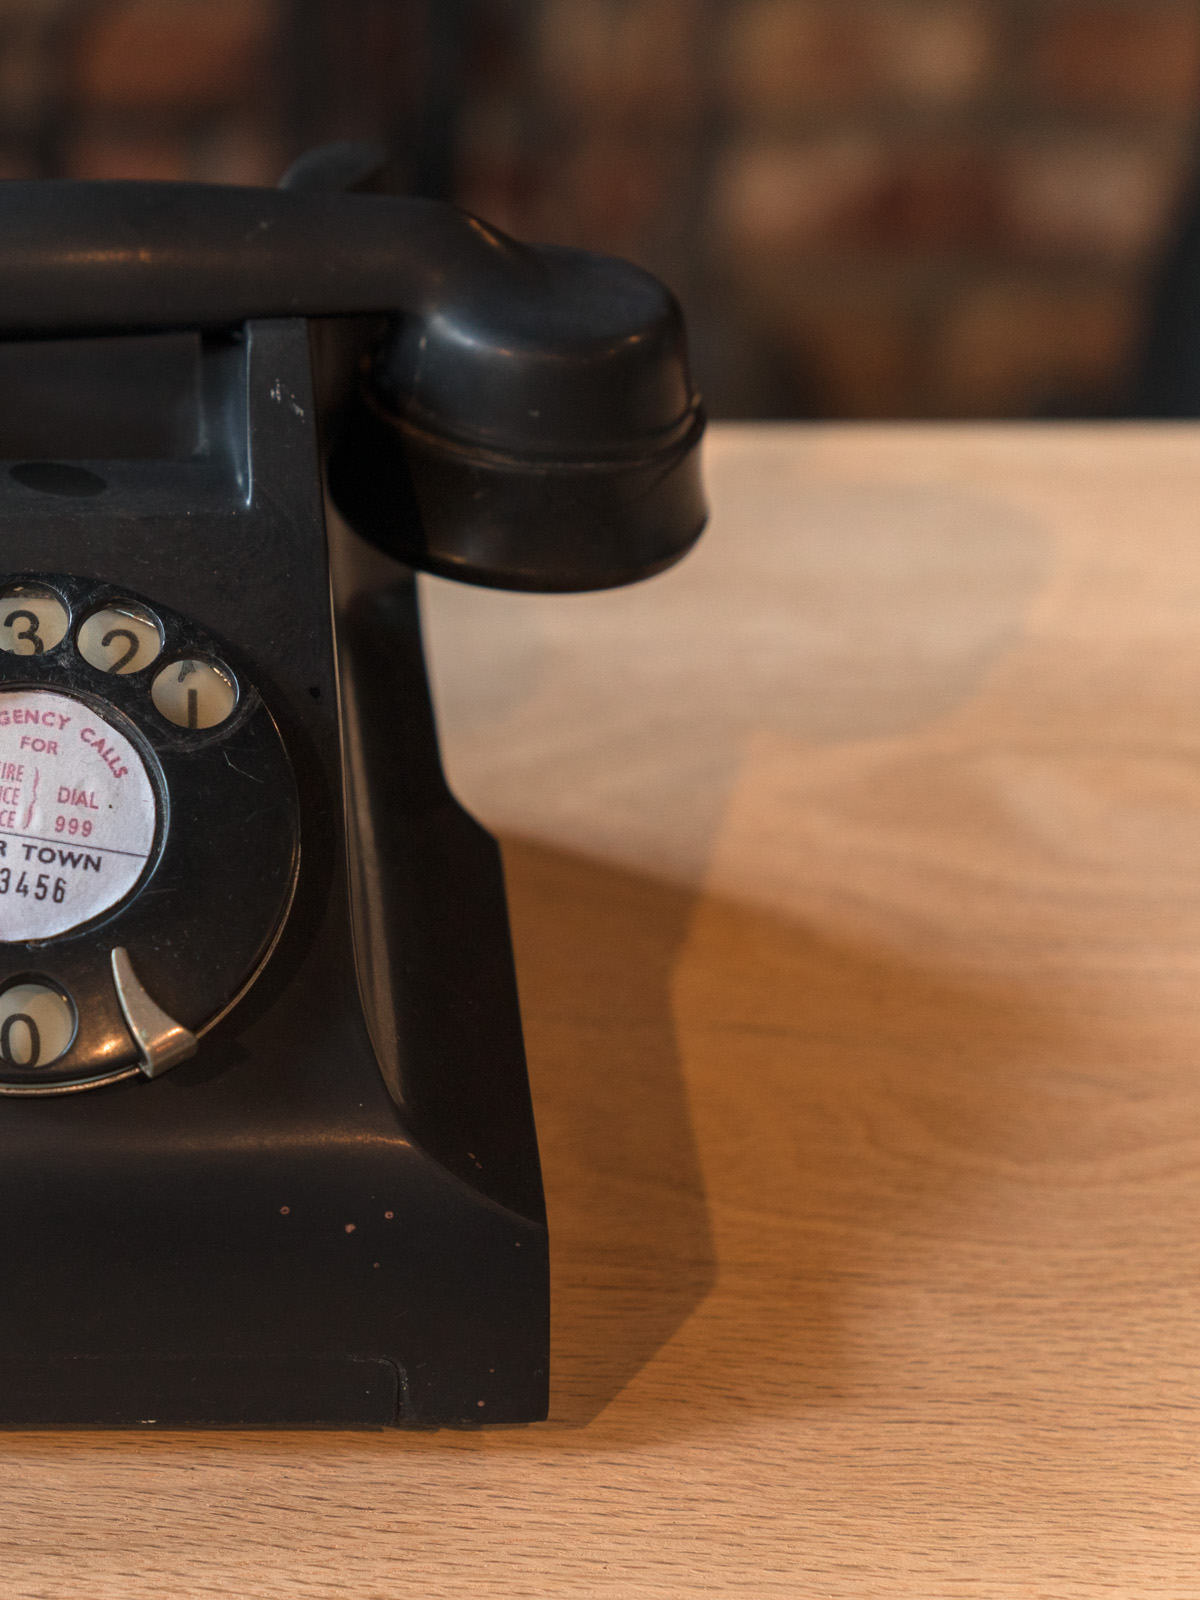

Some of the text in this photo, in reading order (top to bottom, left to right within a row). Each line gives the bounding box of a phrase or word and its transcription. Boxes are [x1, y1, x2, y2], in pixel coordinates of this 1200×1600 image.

[4, 609, 44, 655] 3
[102, 628, 140, 675] 2
[188, 688, 198, 730] 1
[19, 736, 59, 755] FOR
[79, 727, 129, 779] CALLS
[57, 786, 99, 810] DIAL
[55, 815, 93, 837] 999
[22, 843, 102, 872] TOWN
[0, 1013, 40, 1068] 0
